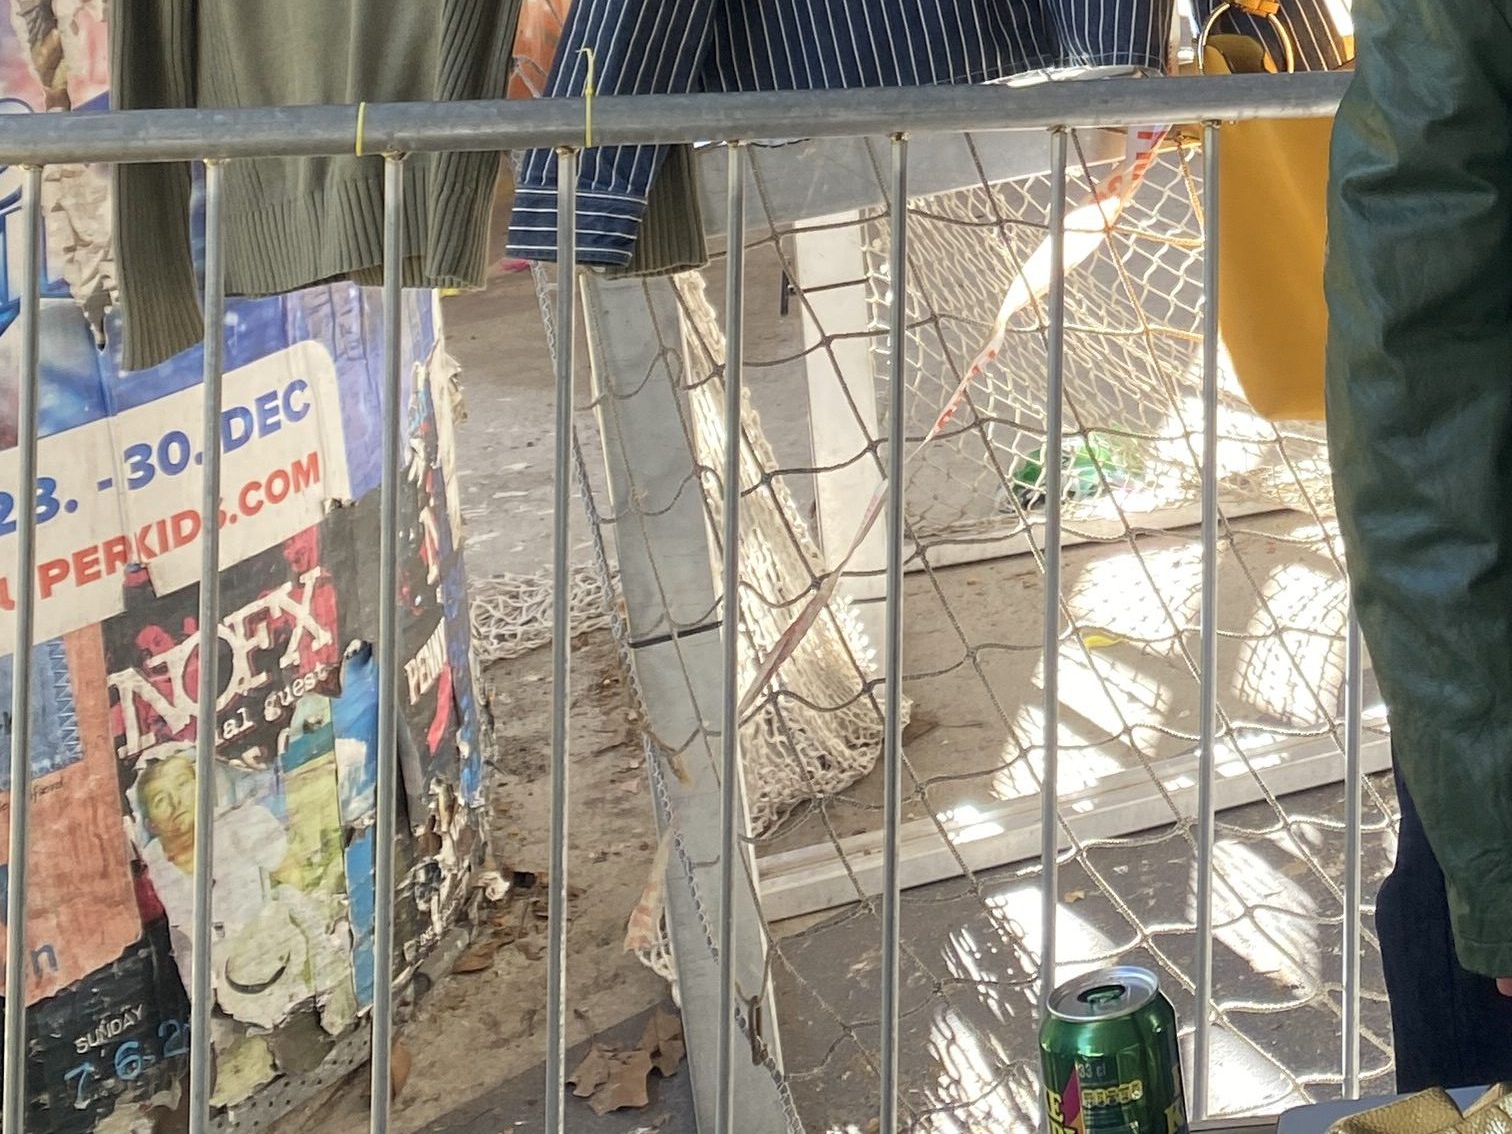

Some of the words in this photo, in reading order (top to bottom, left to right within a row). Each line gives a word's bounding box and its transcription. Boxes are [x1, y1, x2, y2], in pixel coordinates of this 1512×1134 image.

[221, 377, 312, 455] DEC
[107, 566, 333, 757] NOFX
[73, 1003, 144, 1055] SUNDAY
